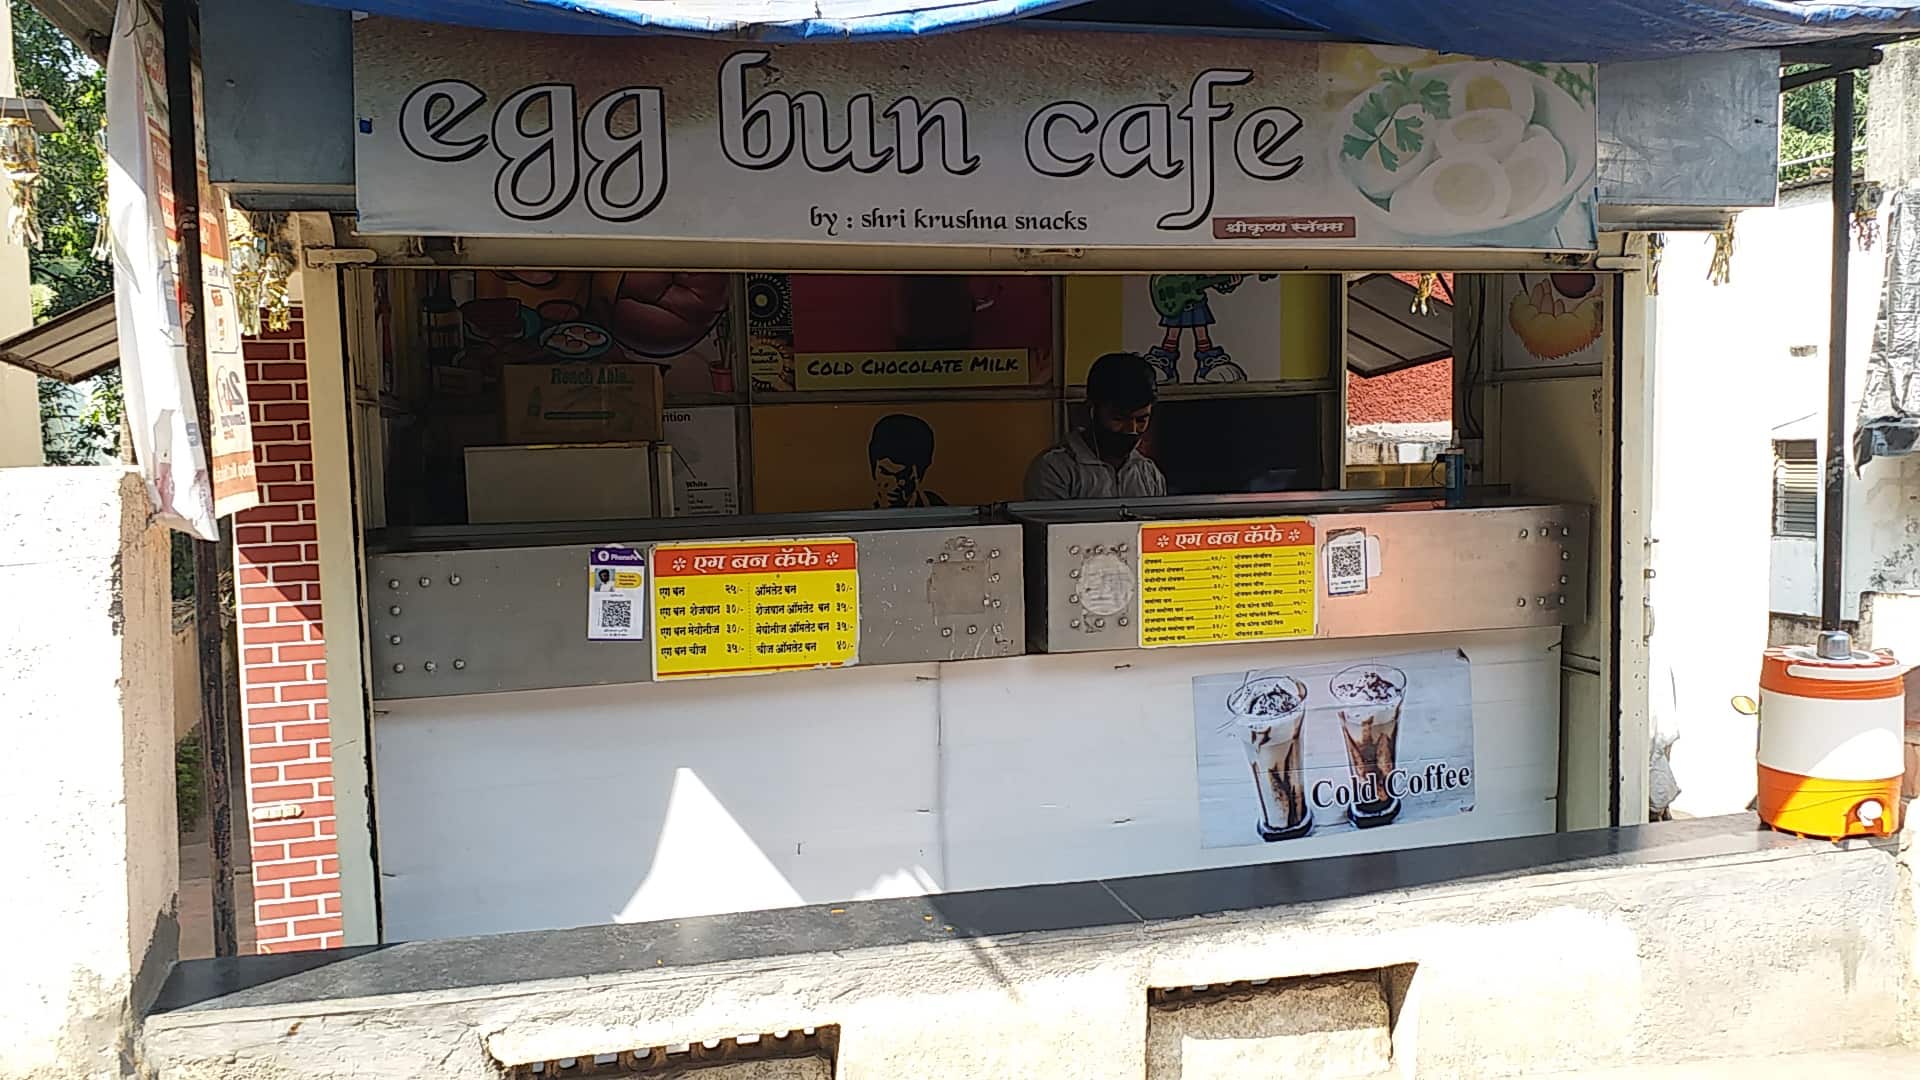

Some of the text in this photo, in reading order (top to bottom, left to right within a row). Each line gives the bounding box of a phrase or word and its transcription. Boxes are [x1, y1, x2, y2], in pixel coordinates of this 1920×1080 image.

[399, 50, 1303, 230] egg bun cafe
[861, 208, 906, 229] shri
[914, 209, 1008, 230] krushna
[1015, 210, 1088, 231] snacks
[1225, 220, 1287, 237] श्रीकृष्ण
[1175, 524, 1285, 549] एग बन कॅफे
[694, 547, 821, 573] एग बन कॅफे
[1312, 763, 1470, 809] Cold Coffee
